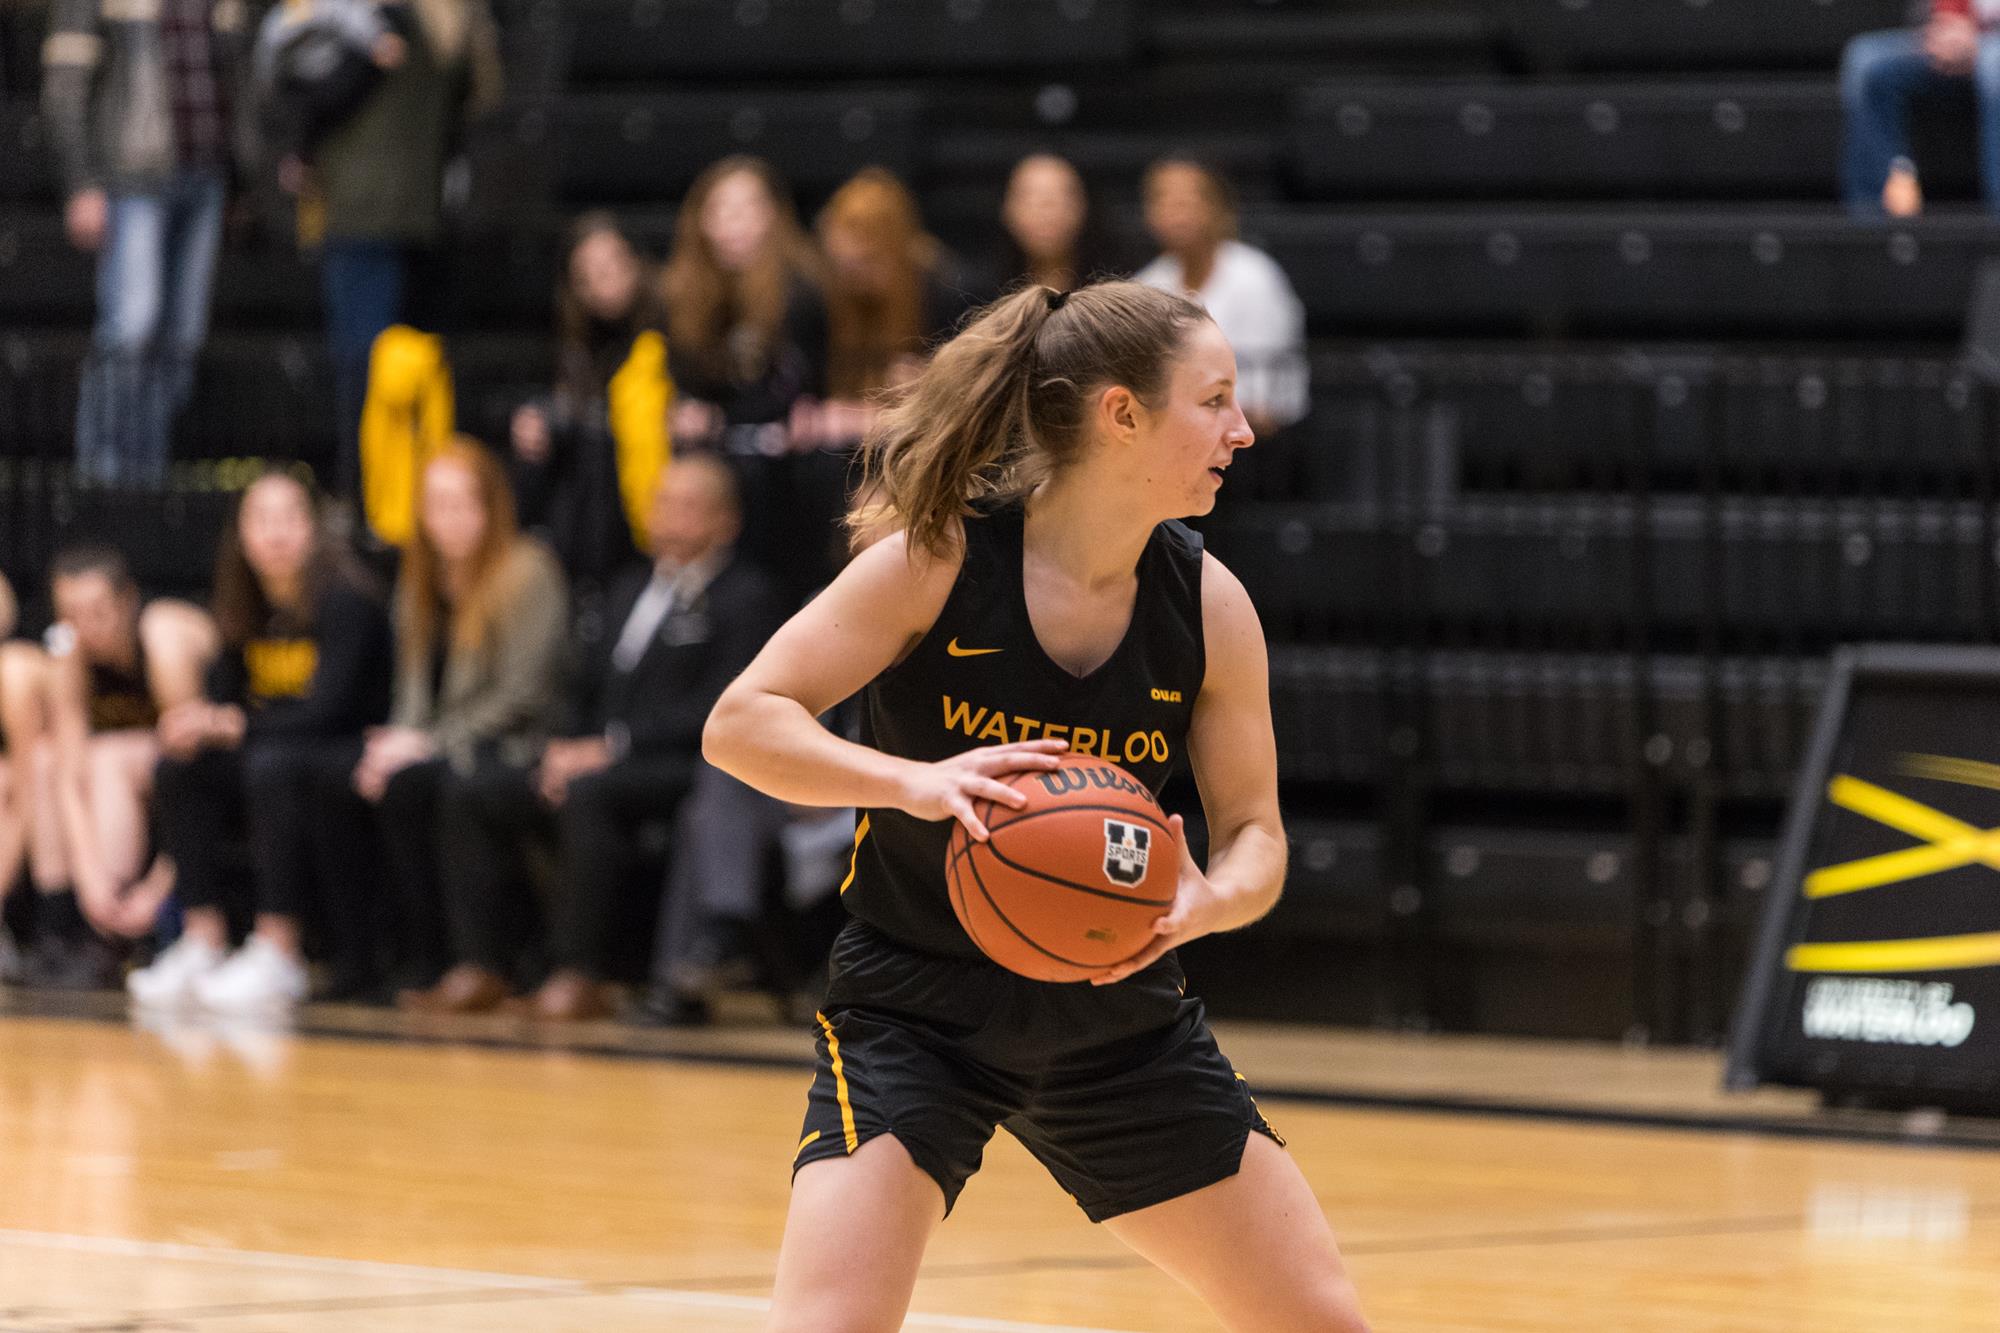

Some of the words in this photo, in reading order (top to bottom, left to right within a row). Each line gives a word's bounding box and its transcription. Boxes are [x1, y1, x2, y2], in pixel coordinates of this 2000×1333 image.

[1151, 688, 1182, 703] OUA
[1034, 766, 1158, 804] Wilso
[1107, 844, 1147, 864] SPORTS
